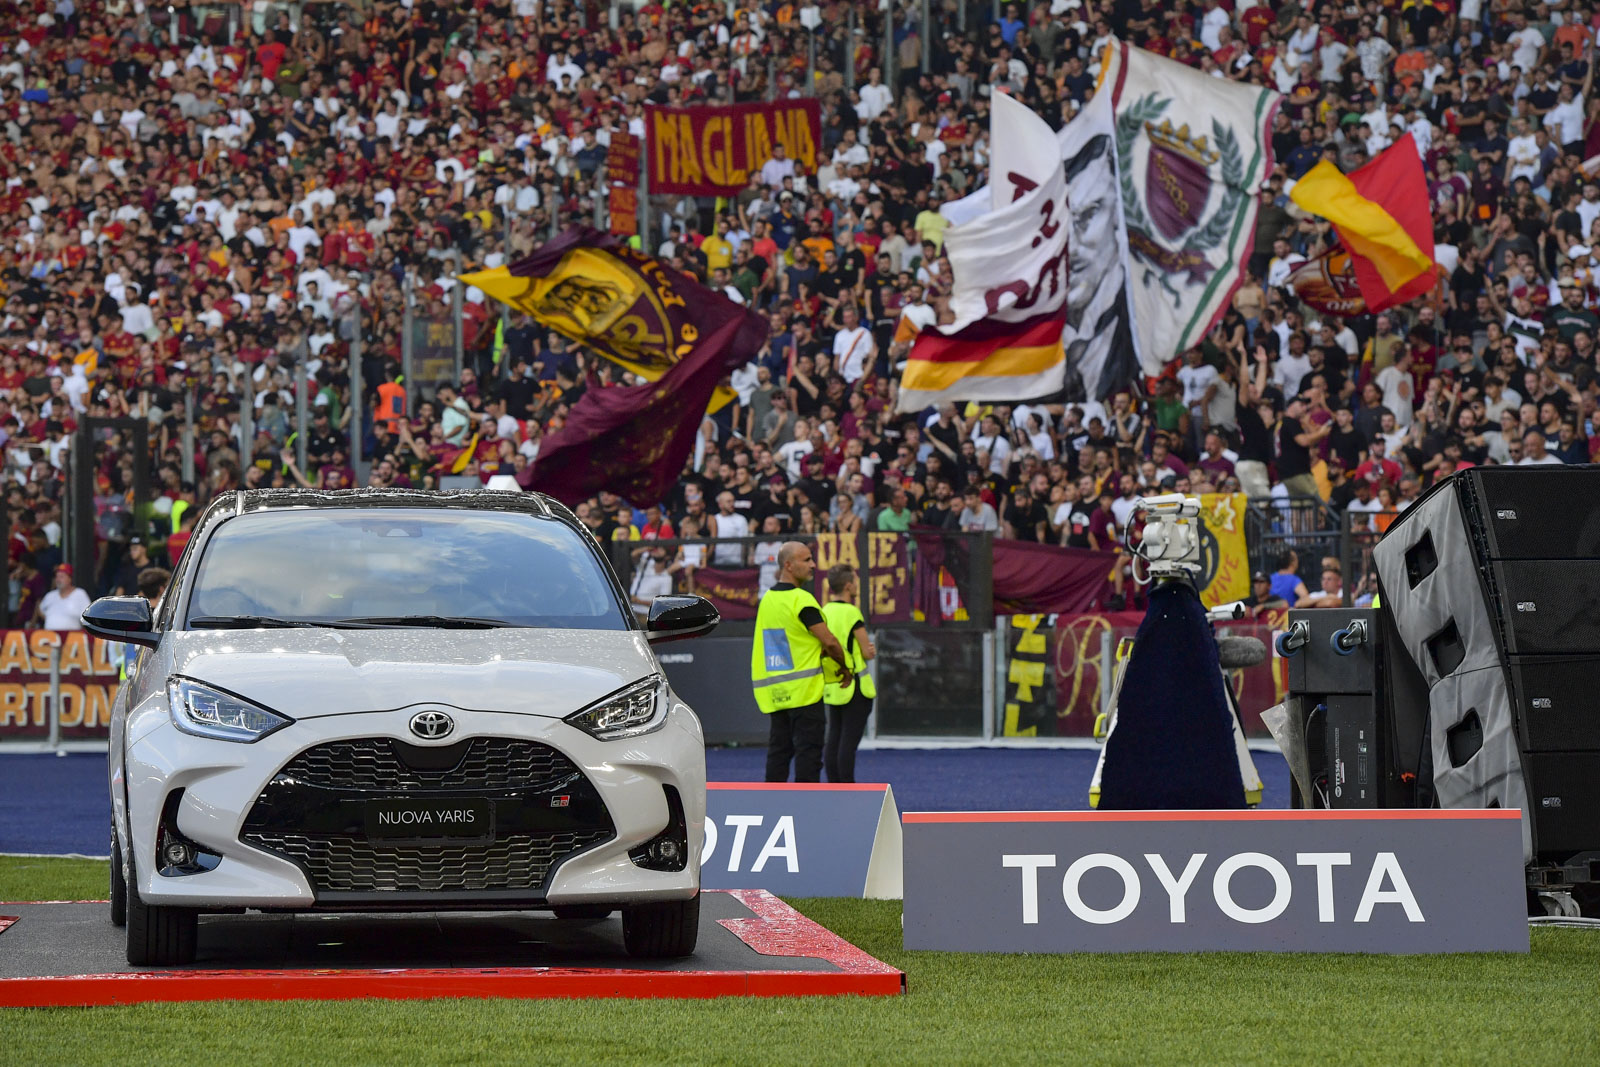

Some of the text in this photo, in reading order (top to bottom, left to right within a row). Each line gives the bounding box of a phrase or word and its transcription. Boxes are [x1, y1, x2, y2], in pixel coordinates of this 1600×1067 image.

[653, 108, 819, 186] MAGLIANA
[0, 630, 118, 676] ASAL
[379, 809, 475, 825] NUOVA YARIS
[1002, 852, 1426, 924] TOYOTA
